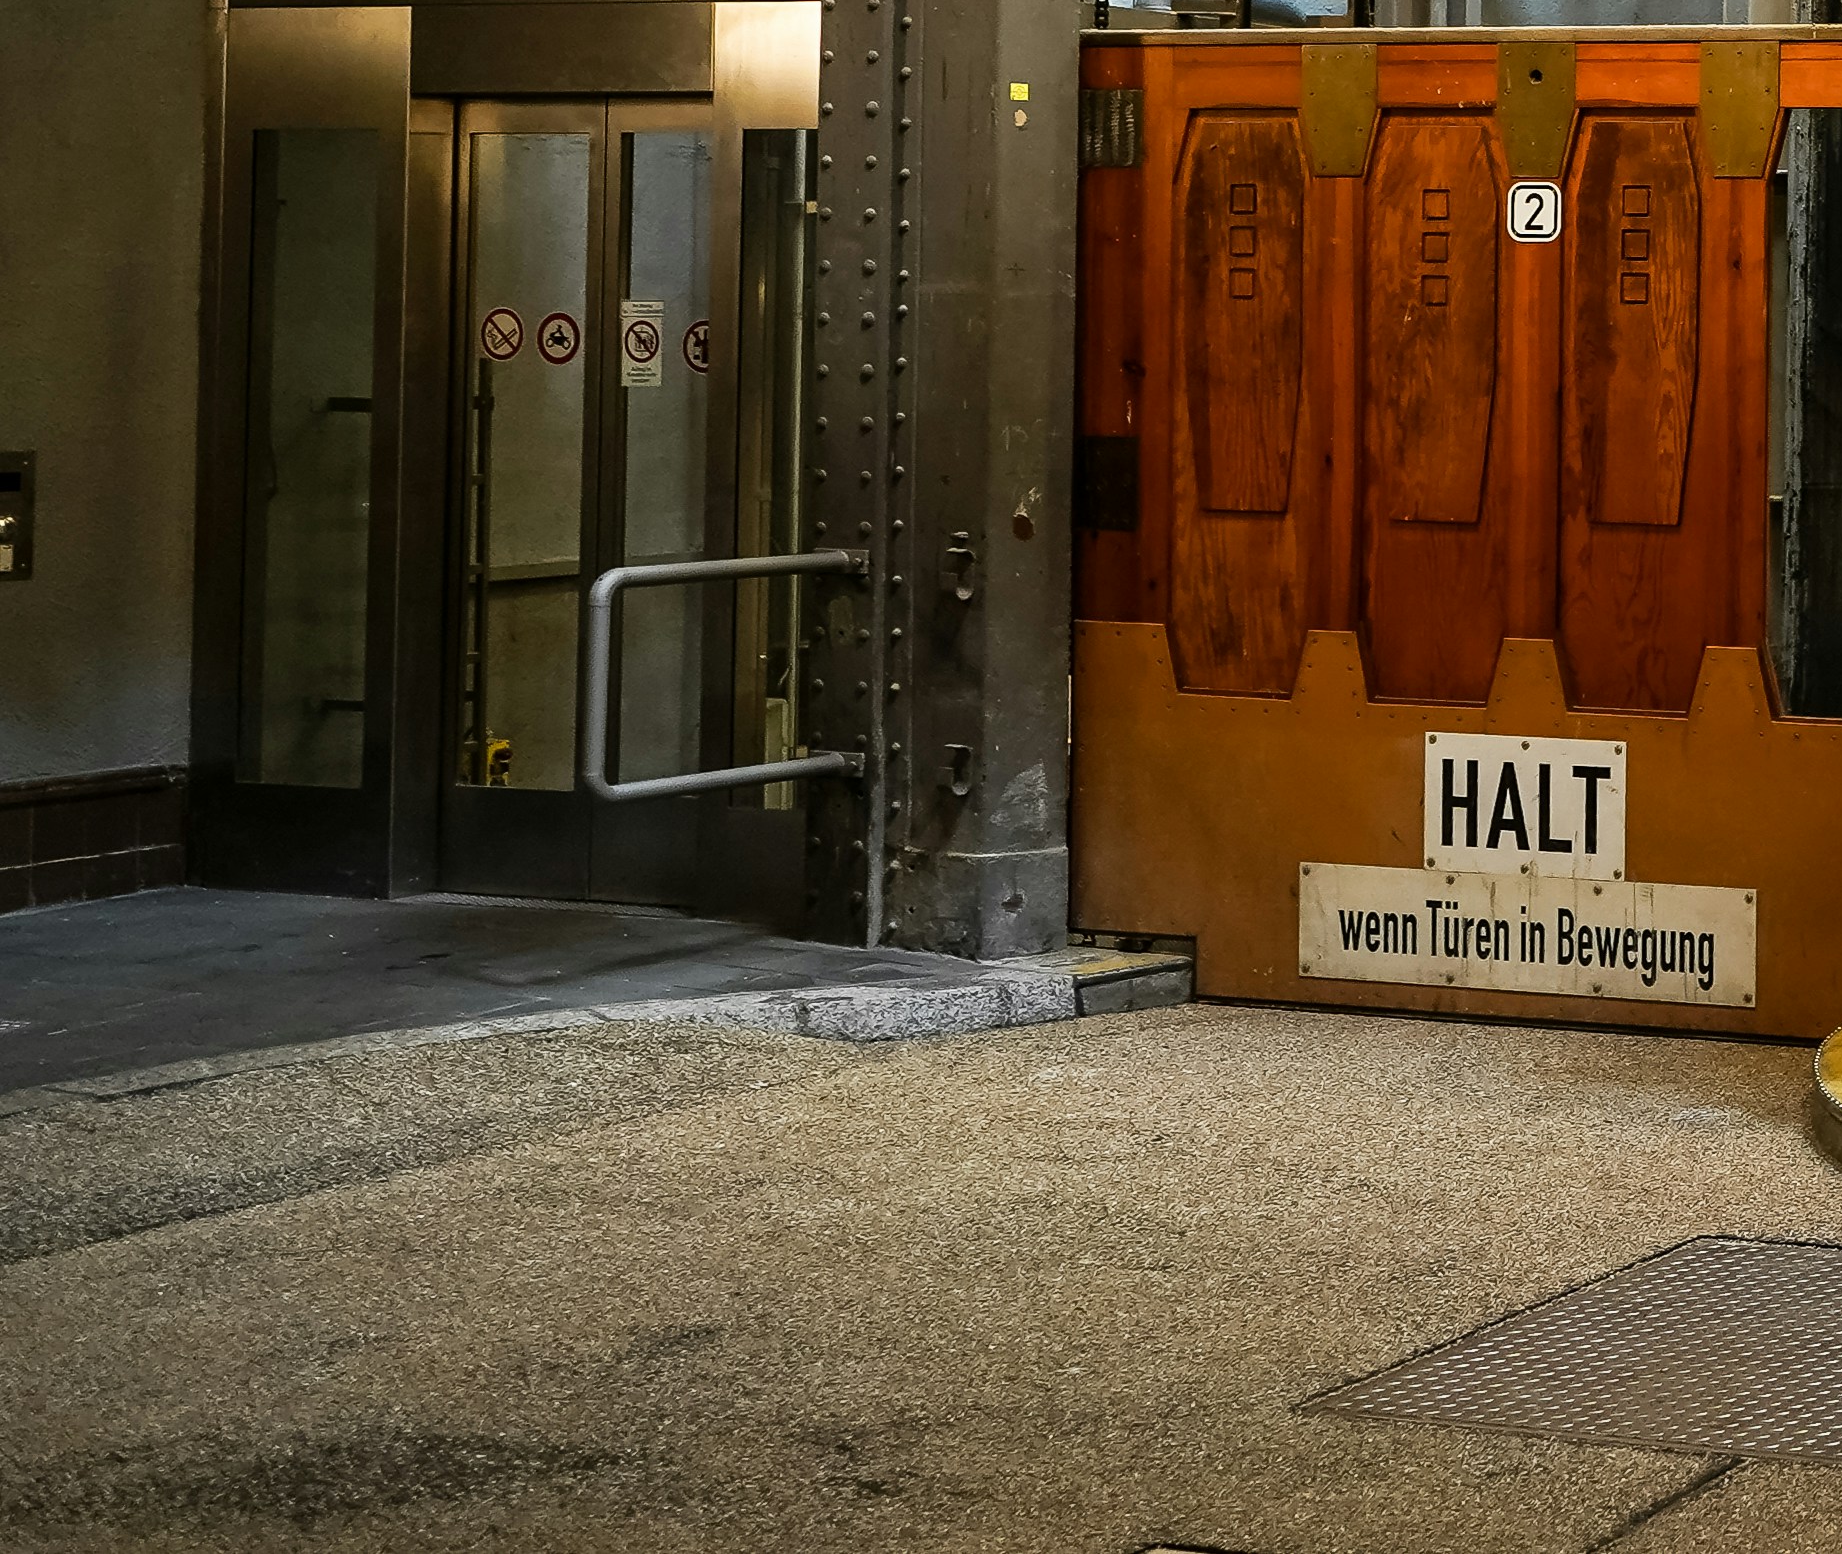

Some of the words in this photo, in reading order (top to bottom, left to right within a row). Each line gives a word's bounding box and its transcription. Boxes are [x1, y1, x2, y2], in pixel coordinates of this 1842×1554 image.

[1525, 193, 1543, 230] 2
[1441, 758, 1611, 855] HALT
[1339, 908, 1418, 956] wenn
[1426, 900, 1510, 961] Türen
[1520, 905, 1546, 964] in
[1557, 907, 1716, 992] Bewegung
